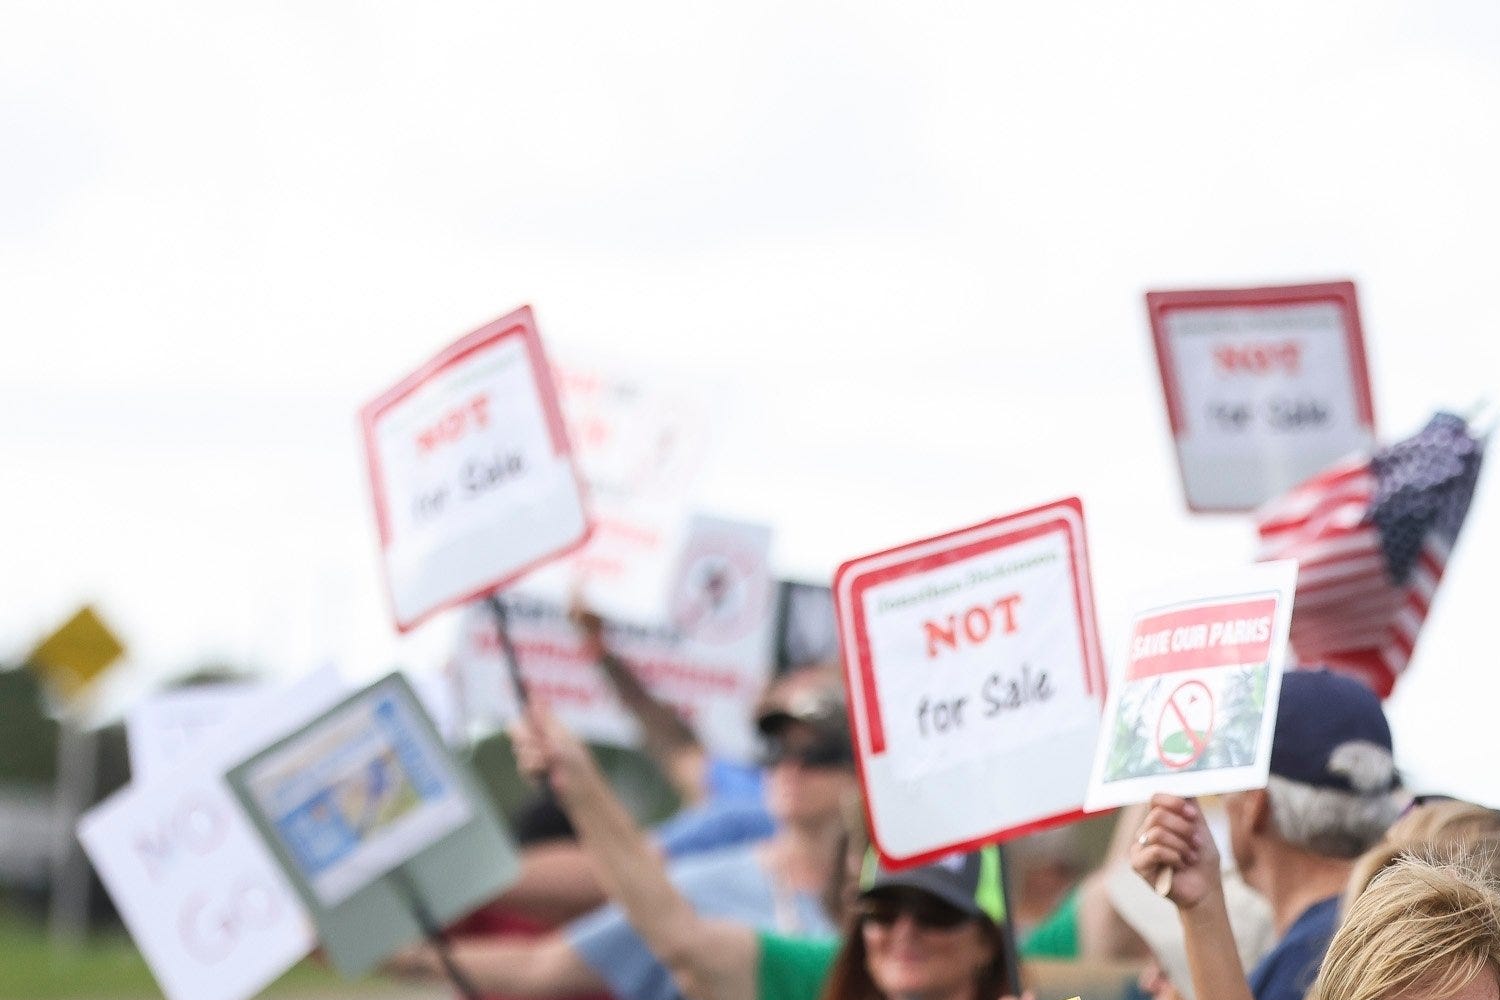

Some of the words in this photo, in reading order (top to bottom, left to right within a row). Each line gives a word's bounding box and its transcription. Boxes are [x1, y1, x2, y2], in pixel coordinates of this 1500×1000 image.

[923, 594, 1023, 659] NOT
[1134, 630, 1171, 660] SAVE
[1170, 623, 1208, 652] OUR
[1208, 615, 1271, 648] PARKS
[916, 696, 970, 738] for
[981, 662, 1056, 719] Sale
